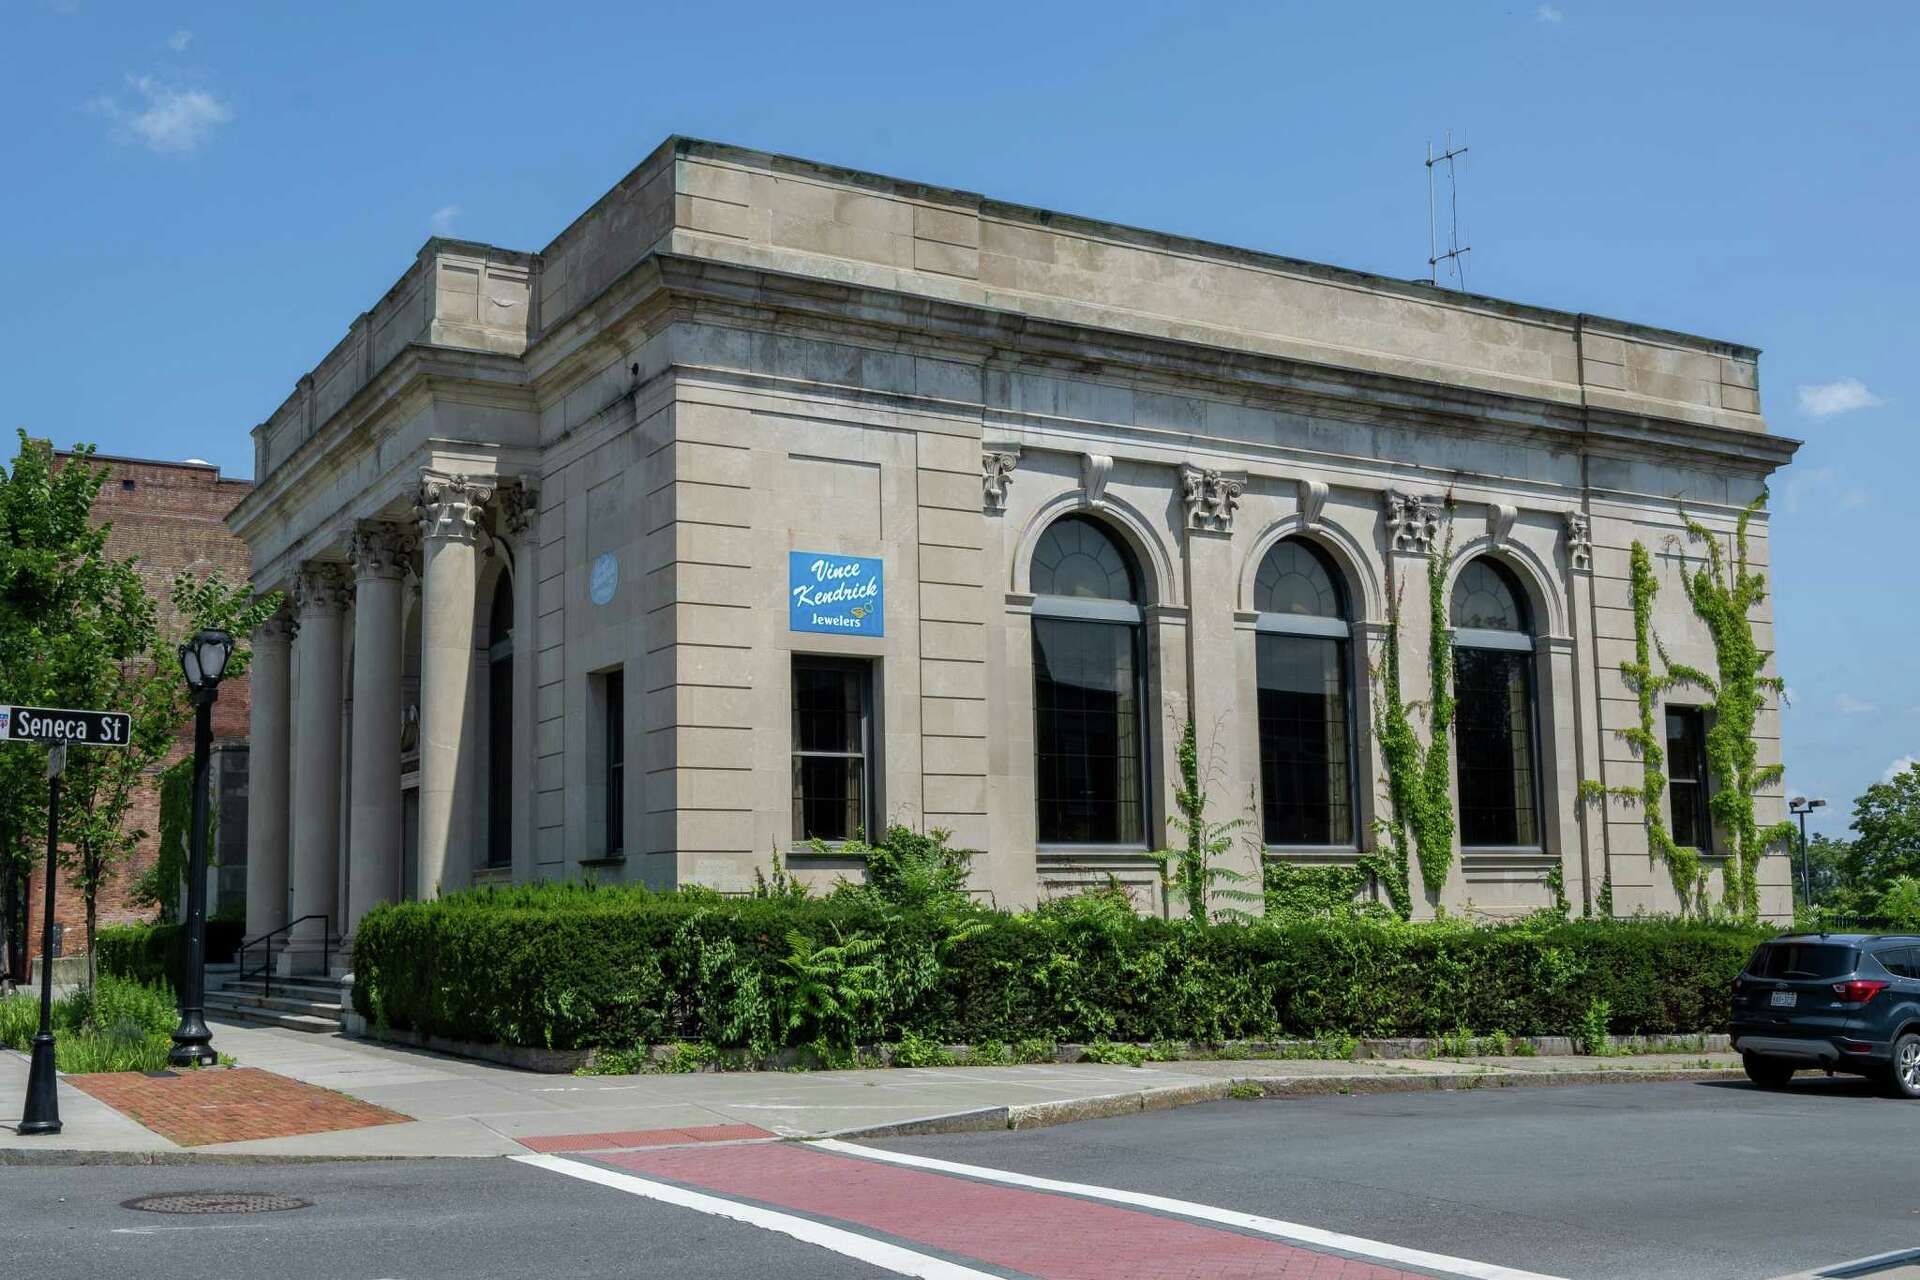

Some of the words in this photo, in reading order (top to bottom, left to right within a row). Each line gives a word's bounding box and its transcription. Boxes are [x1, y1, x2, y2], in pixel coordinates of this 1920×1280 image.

[812, 559, 861, 582] Vince
[793, 576, 878, 607] Kendrick
[811, 613, 861, 628] Jewelers
[17, 711, 87, 739] Seneca
[100, 716, 121, 741] St
